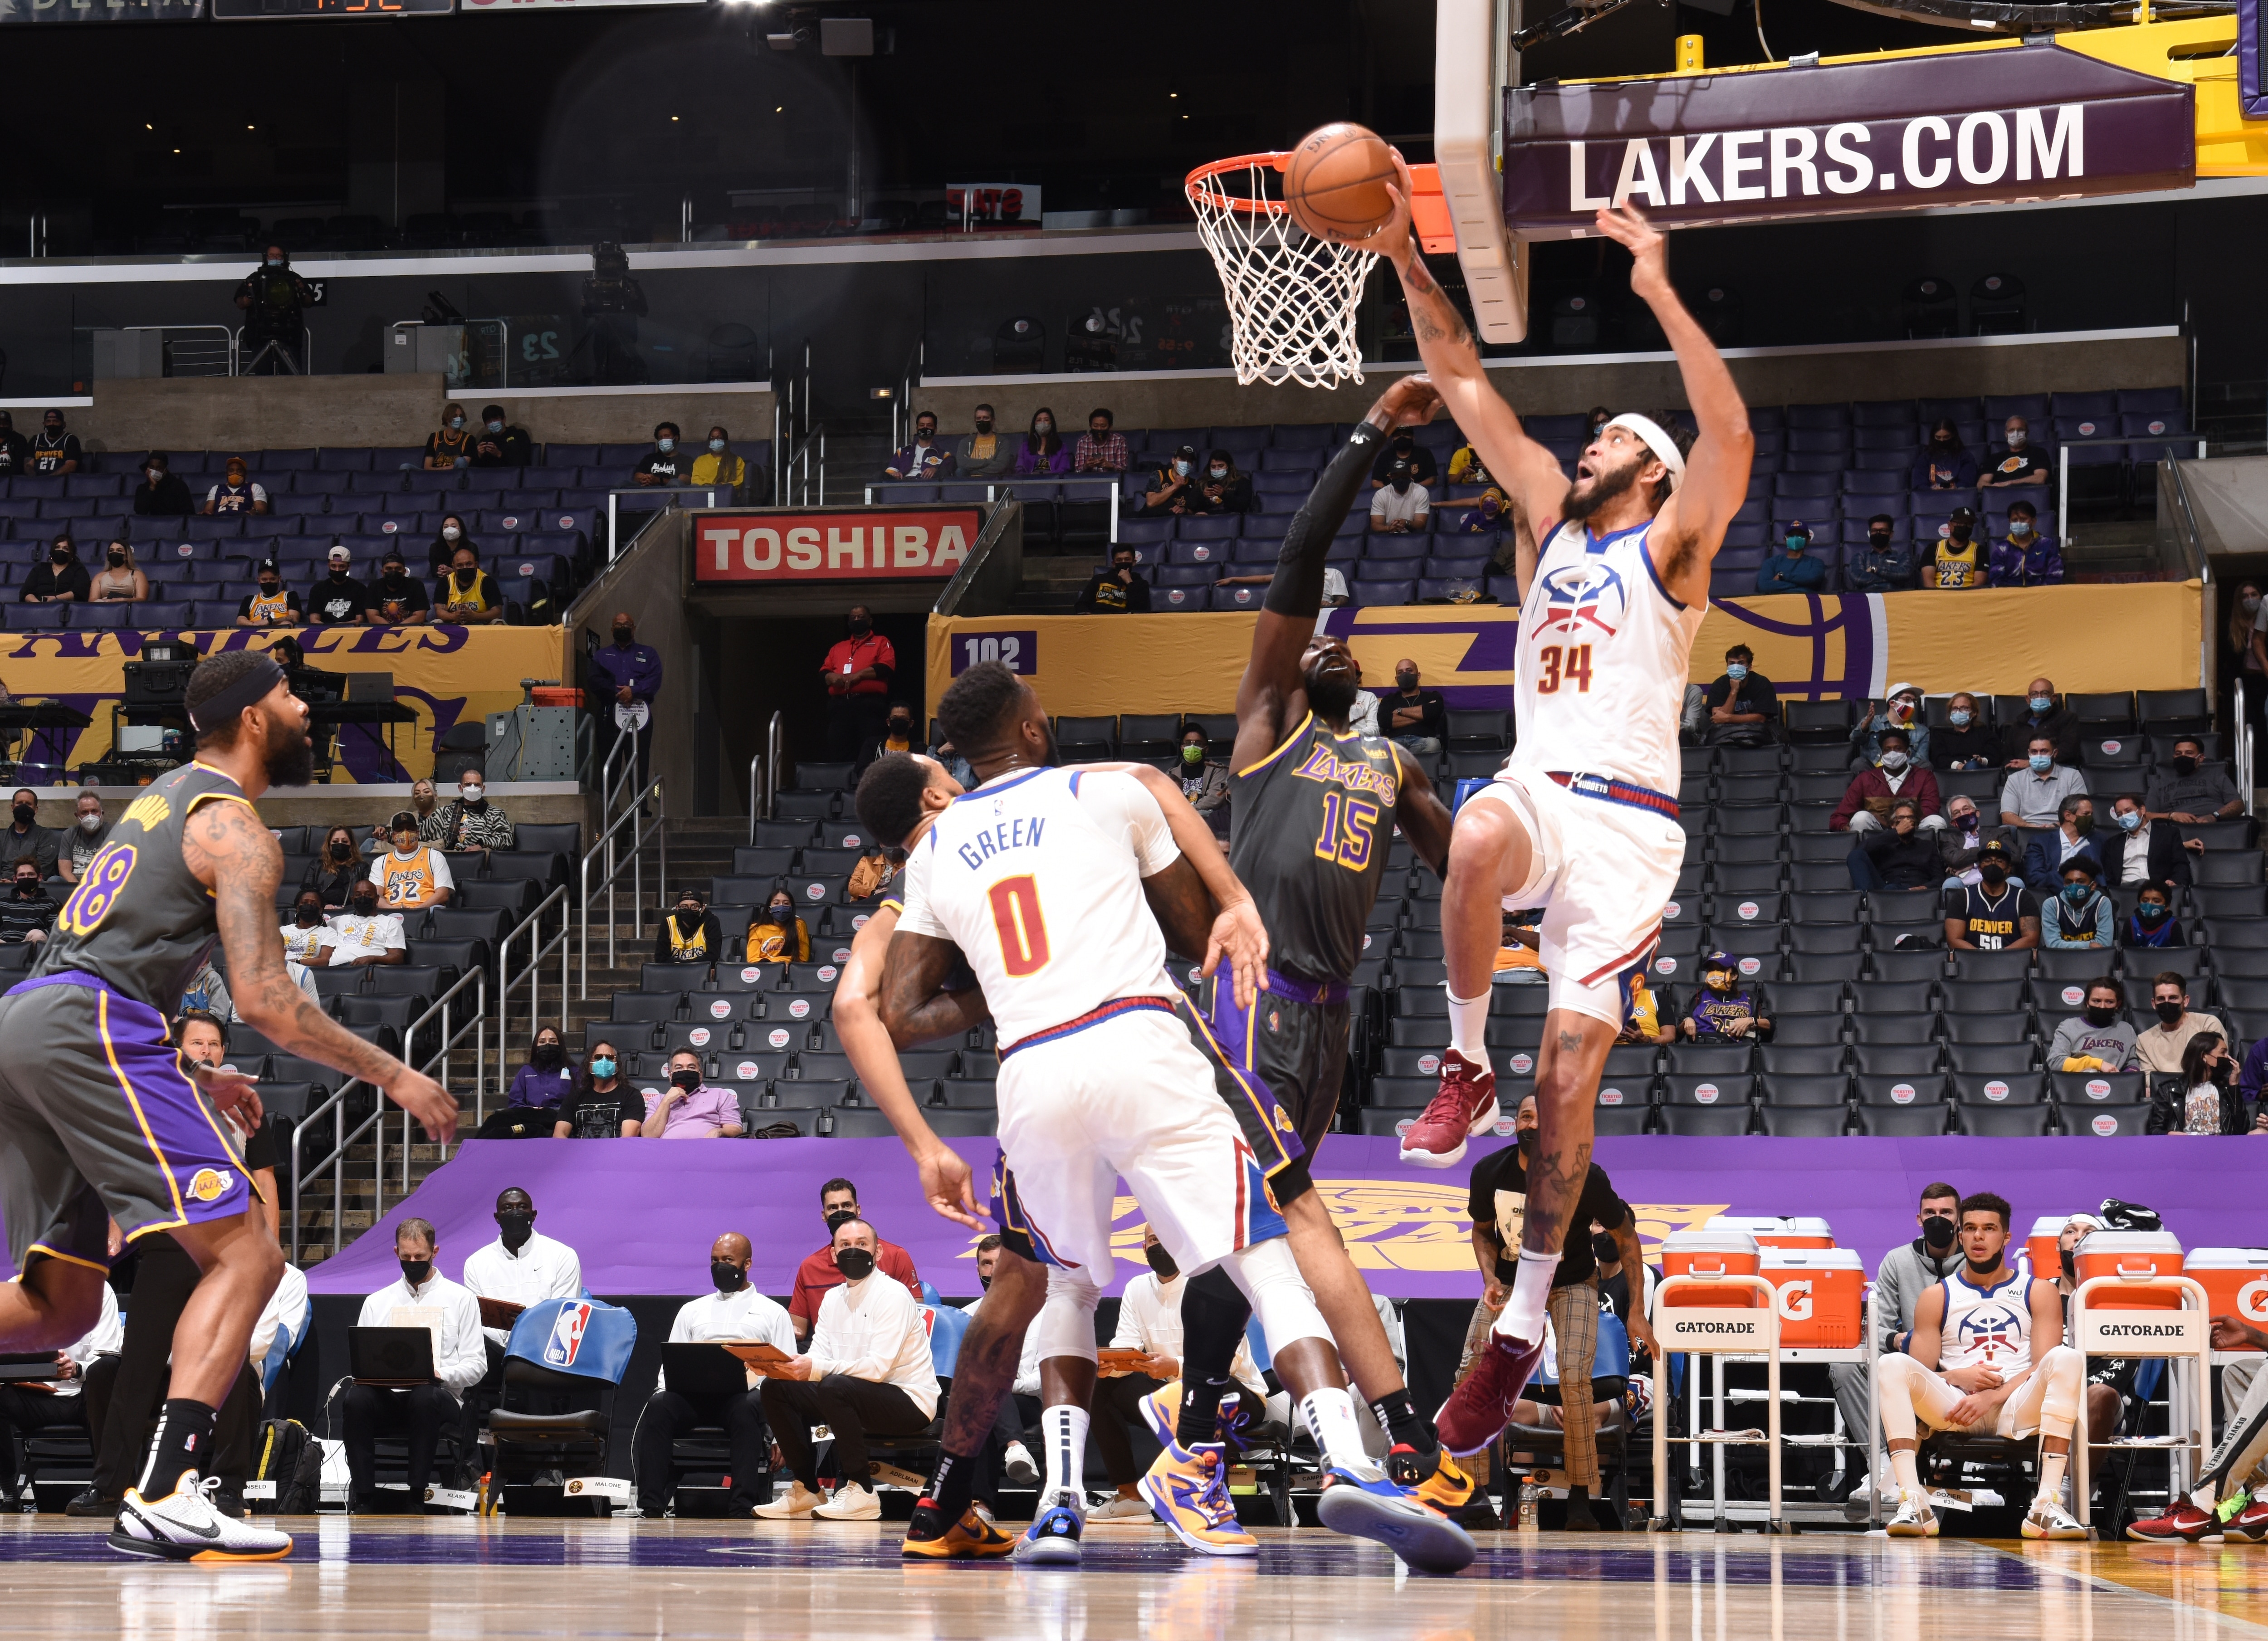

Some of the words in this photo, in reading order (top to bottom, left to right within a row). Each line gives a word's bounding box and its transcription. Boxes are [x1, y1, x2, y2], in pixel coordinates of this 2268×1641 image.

[1570, 104, 2084, 212] LAKERS.COM
[39, 457, 56, 470] 27
[704, 525, 969, 570] TOSHIBA
[1937, 560, 1971, 571] LAKERS
[1940, 571, 1965, 587] 23
[254, 603, 288, 617] LAKERS
[965, 637, 1020, 670] 102
[1537, 643, 1593, 695] 34
[1292, 742, 1395, 807] LAKERS
[1577, 779, 1609, 794] NUGGETS
[1315, 791, 1378, 872] 15
[958, 817, 1046, 870] GREEN
[387, 868, 424, 887] LAKERS
[389, 881, 421, 903] 32
[987, 872, 1051, 978] 0
[1970, 918, 2013, 934] DENVER
[361, 922, 378, 947] LAKERS
[1979, 934, 2002, 950] 50
[671, 946, 704, 960] LAKERS
[1700, 1003, 1750, 1018] LAKERS
[2080, 1036, 2125, 1053] LAKERS
[186, 1176, 234, 1198] LAKERS
[1777, 1280, 1813, 1321] G
[1676, 1322, 1755, 1334] GATORADE
[2099, 1324, 2185, 1337] GATORADE
[548, 1348, 565, 1361] NBA
[2227, 1416, 2247, 1441] DENVER
[2204, 1441, 2229, 1470] NUGGETS
[890, 1470, 919, 1485] ADELMAN
[1520, 1505, 1528, 1515] G
